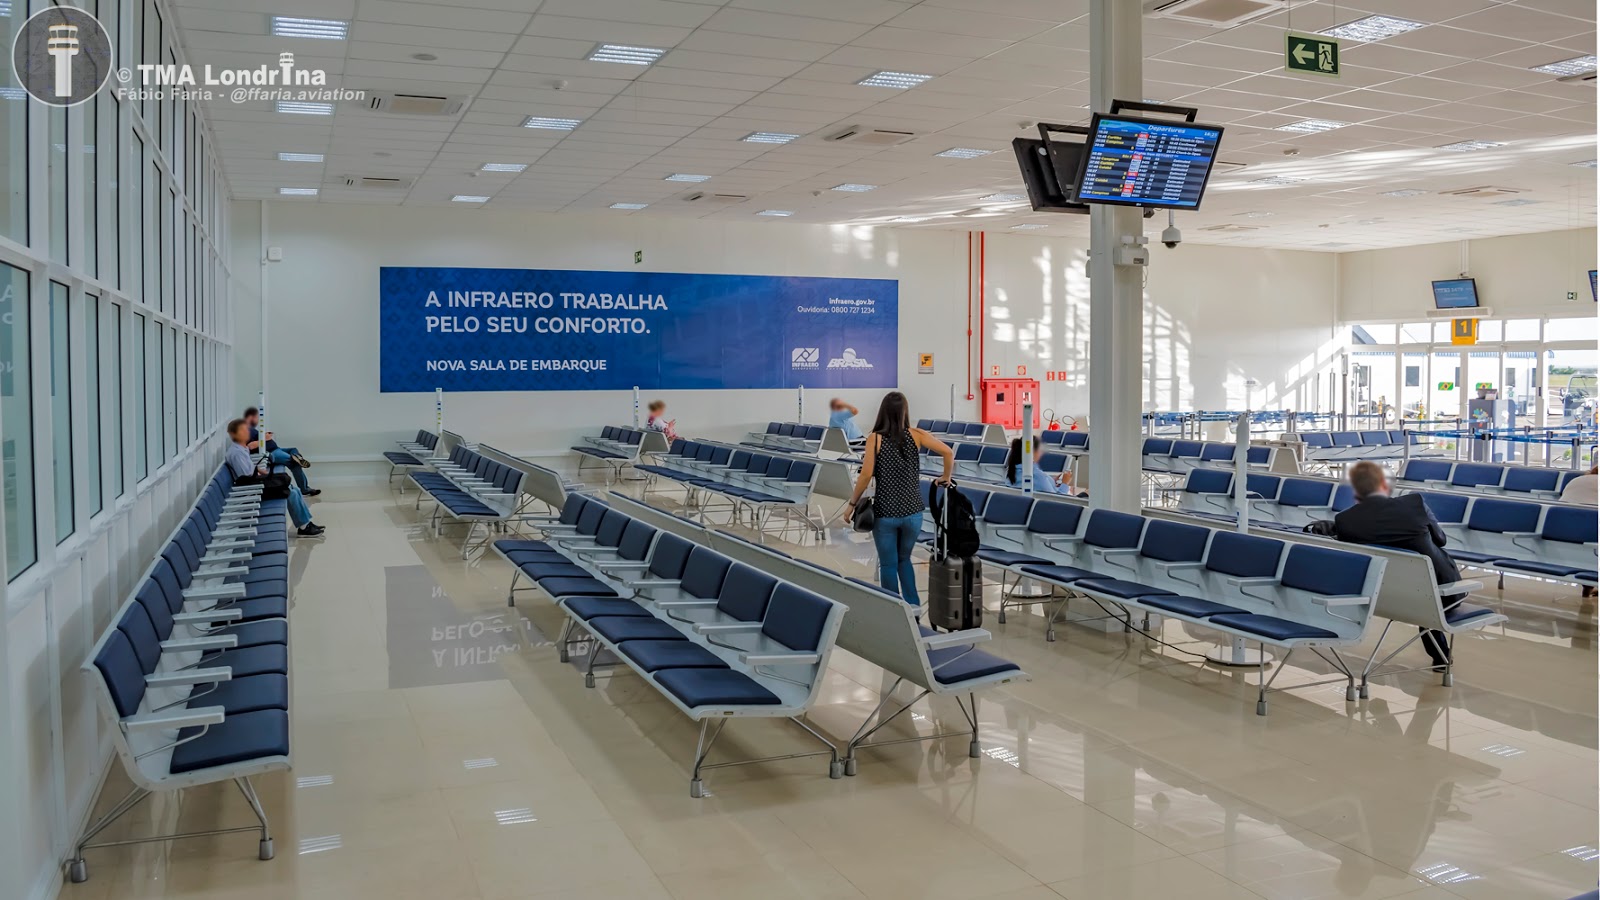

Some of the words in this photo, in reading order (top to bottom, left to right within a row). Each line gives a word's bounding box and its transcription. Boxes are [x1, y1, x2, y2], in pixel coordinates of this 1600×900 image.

[1148, 125, 1186, 134] Departures
[425, 290, 441, 307] A
[448, 290, 554, 309] INFRAERO
[560, 292, 668, 310] TRABALHA
[829, 297, 875, 306] infraero.gov.br
[797, 305, 830, 314] Ouvidoria:
[831, 306, 848, 314] 0800
[849, 306, 860, 314] 727
[425, 316, 480, 333] PELO
[487, 316, 527, 333] SEU
[534, 316, 651, 334] CONFORTO.
[1460, 320, 1467, 334] 1
[426, 359, 466, 371] NOVA
[470, 359, 506, 371] SALA
[509, 359, 528, 371] DE
[531, 359, 607, 373] EMBARQUE
[827, 358, 874, 368] BRASIL
